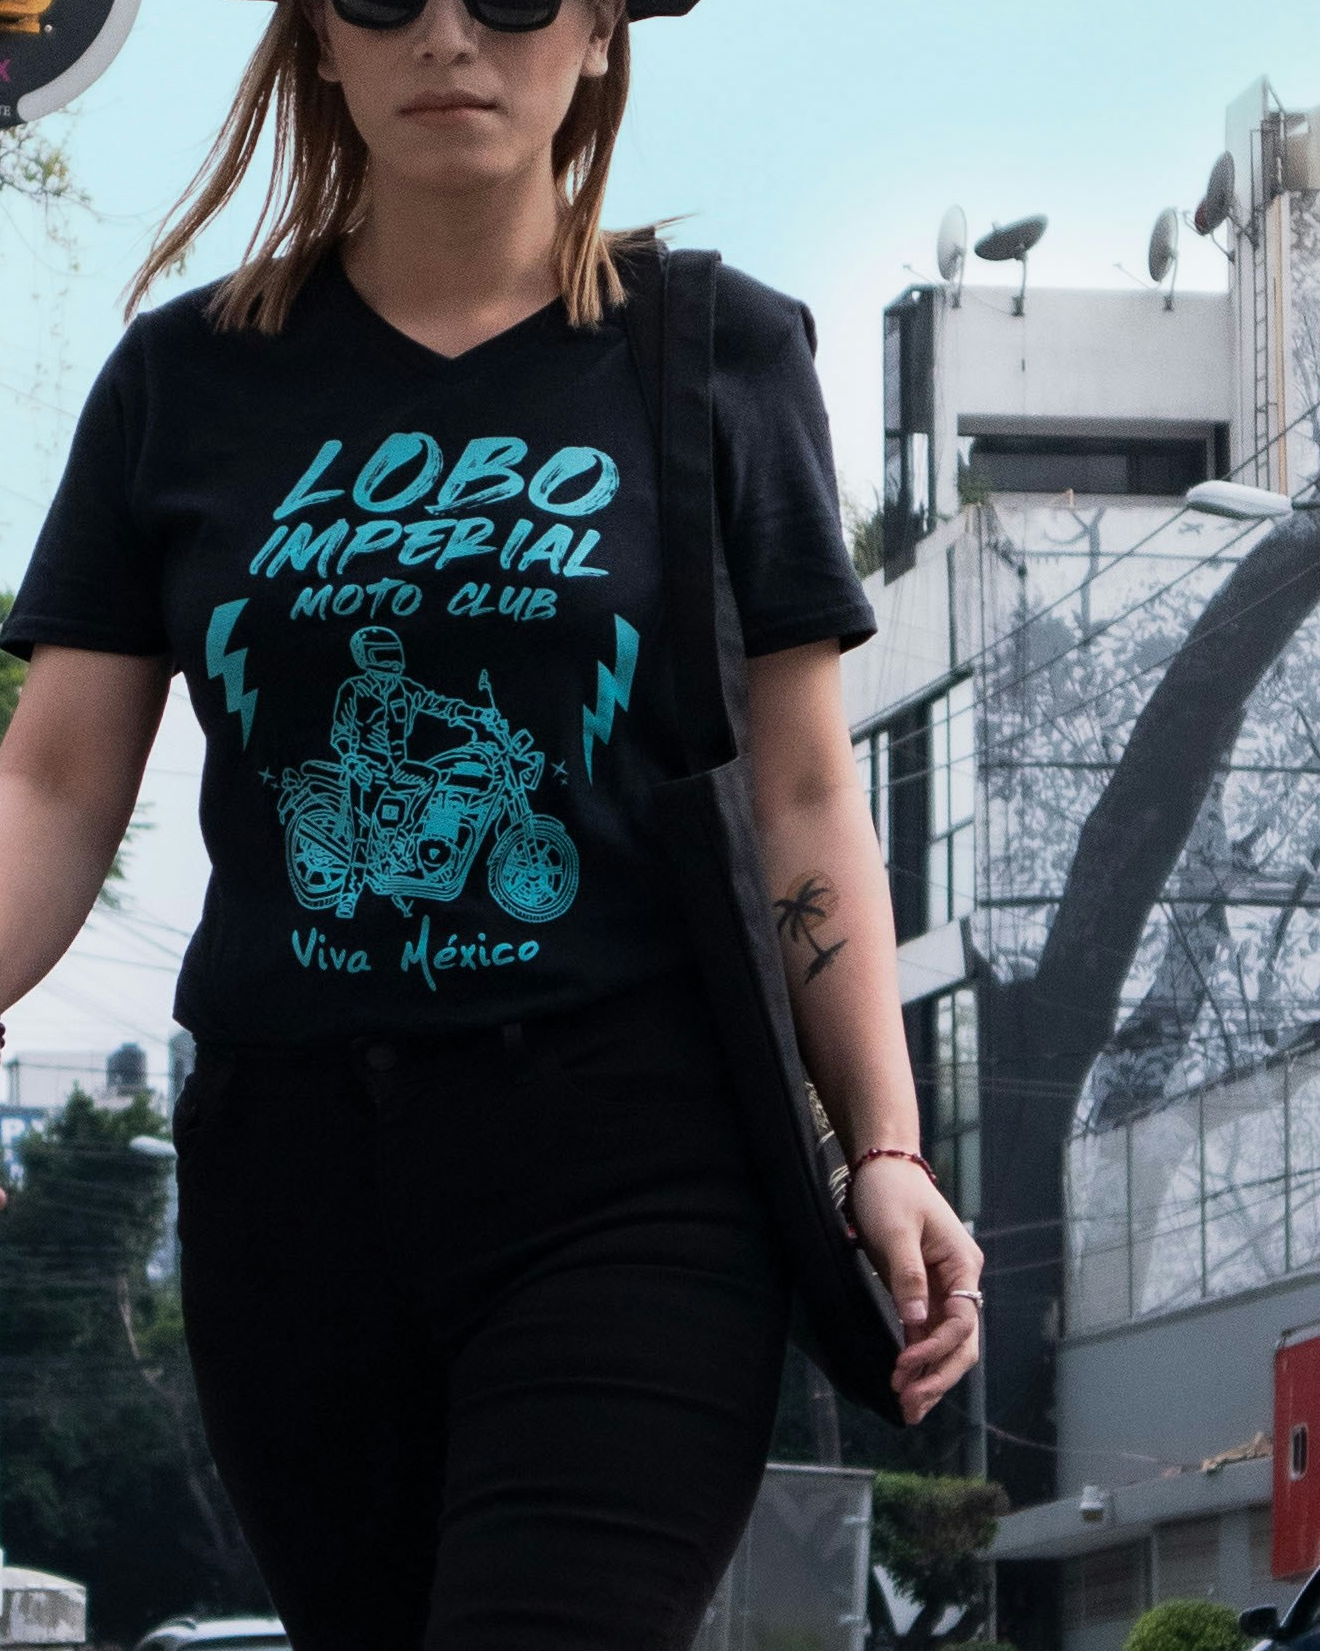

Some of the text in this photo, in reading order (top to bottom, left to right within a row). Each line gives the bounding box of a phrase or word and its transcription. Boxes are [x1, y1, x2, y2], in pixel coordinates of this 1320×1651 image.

[272, 431, 621, 520] LOBO
[248, 516, 610, 579] IMPERIAL
[289, 576, 558, 622] MOTO CLUB
[291, 914, 540, 992] Viva México
